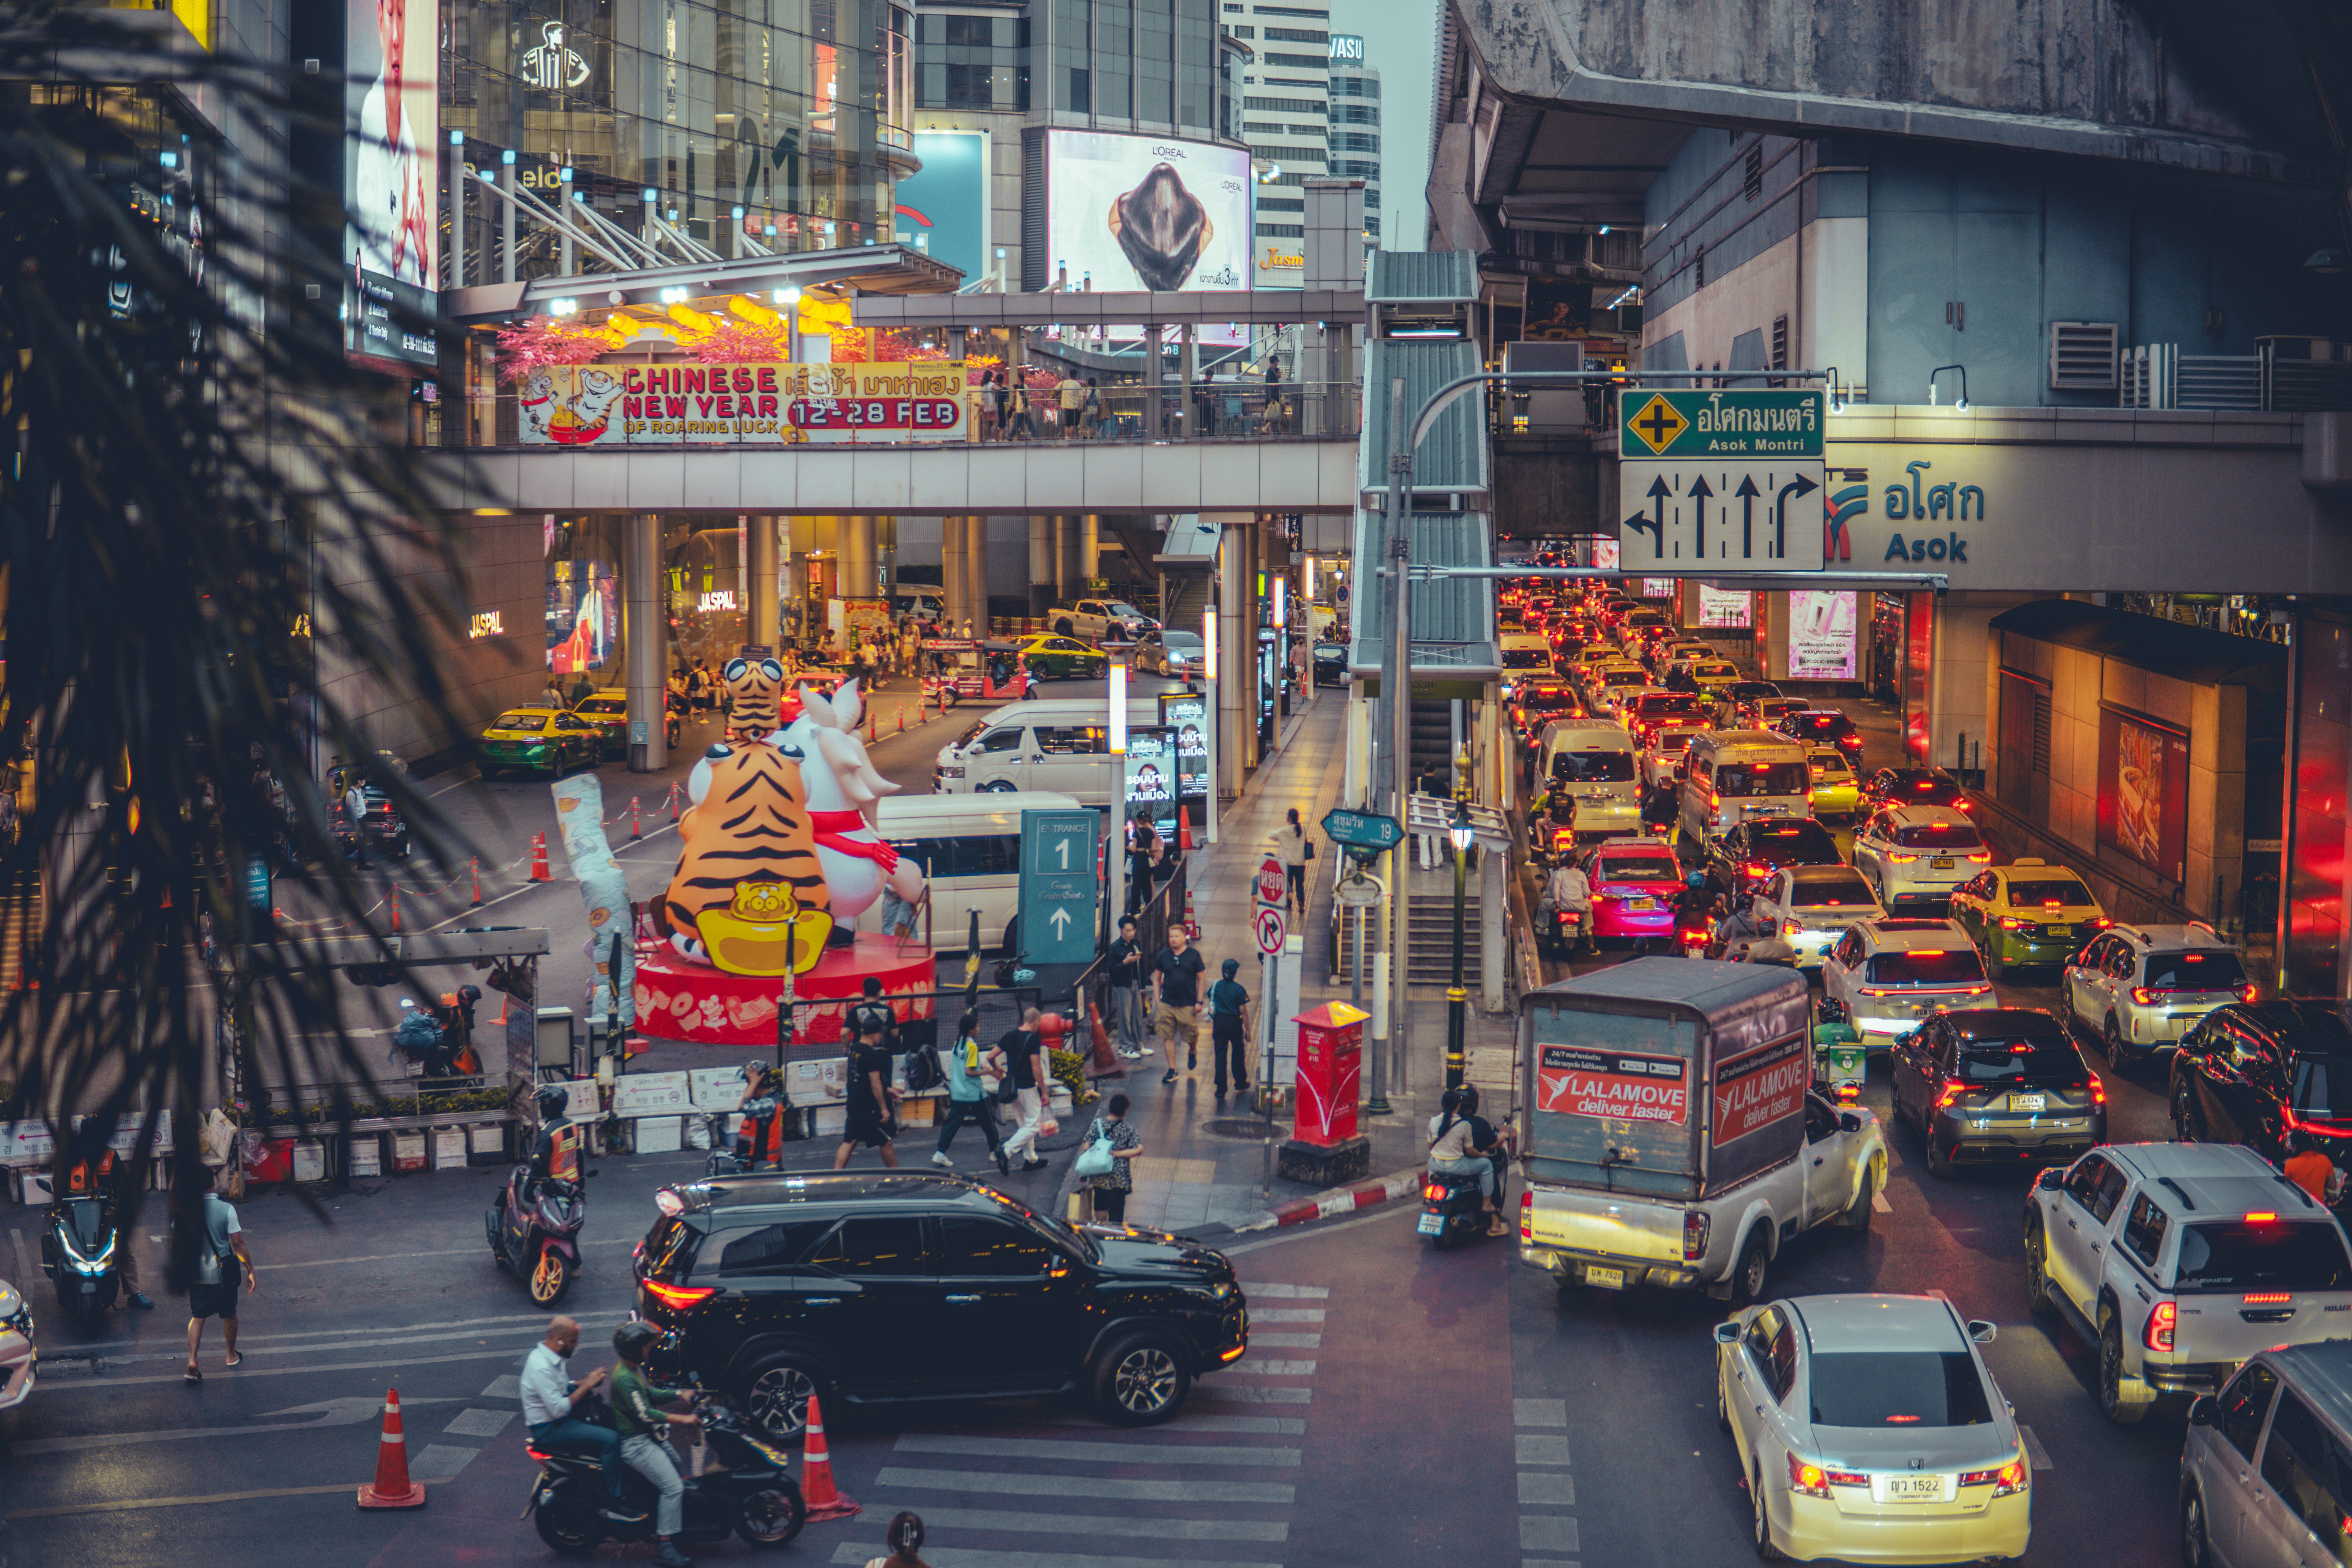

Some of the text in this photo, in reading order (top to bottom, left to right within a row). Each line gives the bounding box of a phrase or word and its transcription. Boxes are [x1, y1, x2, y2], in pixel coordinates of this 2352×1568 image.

[1153, 146, 1186, 158] L'ORÉAL
[1221, 181, 1242, 191] L'ORÉAL
[1225, 268, 1230, 285] 3
[623, 367, 780, 394] CHINESE
[864, 375, 960, 396] มาหาเฮง
[623, 395, 779, 419] NEW YEAR
[897, 402, 955, 424] FEB
[1698, 393, 1815, 432] อโศกมนตรี
[624, 421, 779, 434] OF ROARING LUCK
[1709, 439, 1804, 450] Asok Montri
[1884, 460, 1985, 521] อโศก
[1884, 532, 1967, 560] Asok
[697, 590, 737, 613] JASPAL
[468, 610, 504, 639] JASPAL
[1179, 745, 1208, 757] านเมือง
[1126, 771, 1169, 784] รอบบ้าน
[1126, 788, 1170, 802] งานเมือง
[1041, 824, 1087, 833] ETRANCE
[1333, 815, 1392, 839] สุขุมวิท 19
[1056, 838, 1069, 869] 1
[1260, 869, 1284, 897] หยุด
[1545, 1058, 1608, 1073] ให้บริการทุกวัน ไม่มีวันหยุด
[1566, 1052, 1601, 1061] ขนย้ายเร่งด่วน
[1570, 1079, 1684, 1106] LALAMOVE
[1734, 1059, 1803, 1111] LALAMOVE
[1577, 1098, 1675, 1120] deliver faster
[1744, 1095, 1792, 1129] deliver faster
[1535, 1229, 1565, 1239] NAVARA
[1605, 1271, 1622, 1280] 7528
[1913, 1481, 1939, 1492] 1522
